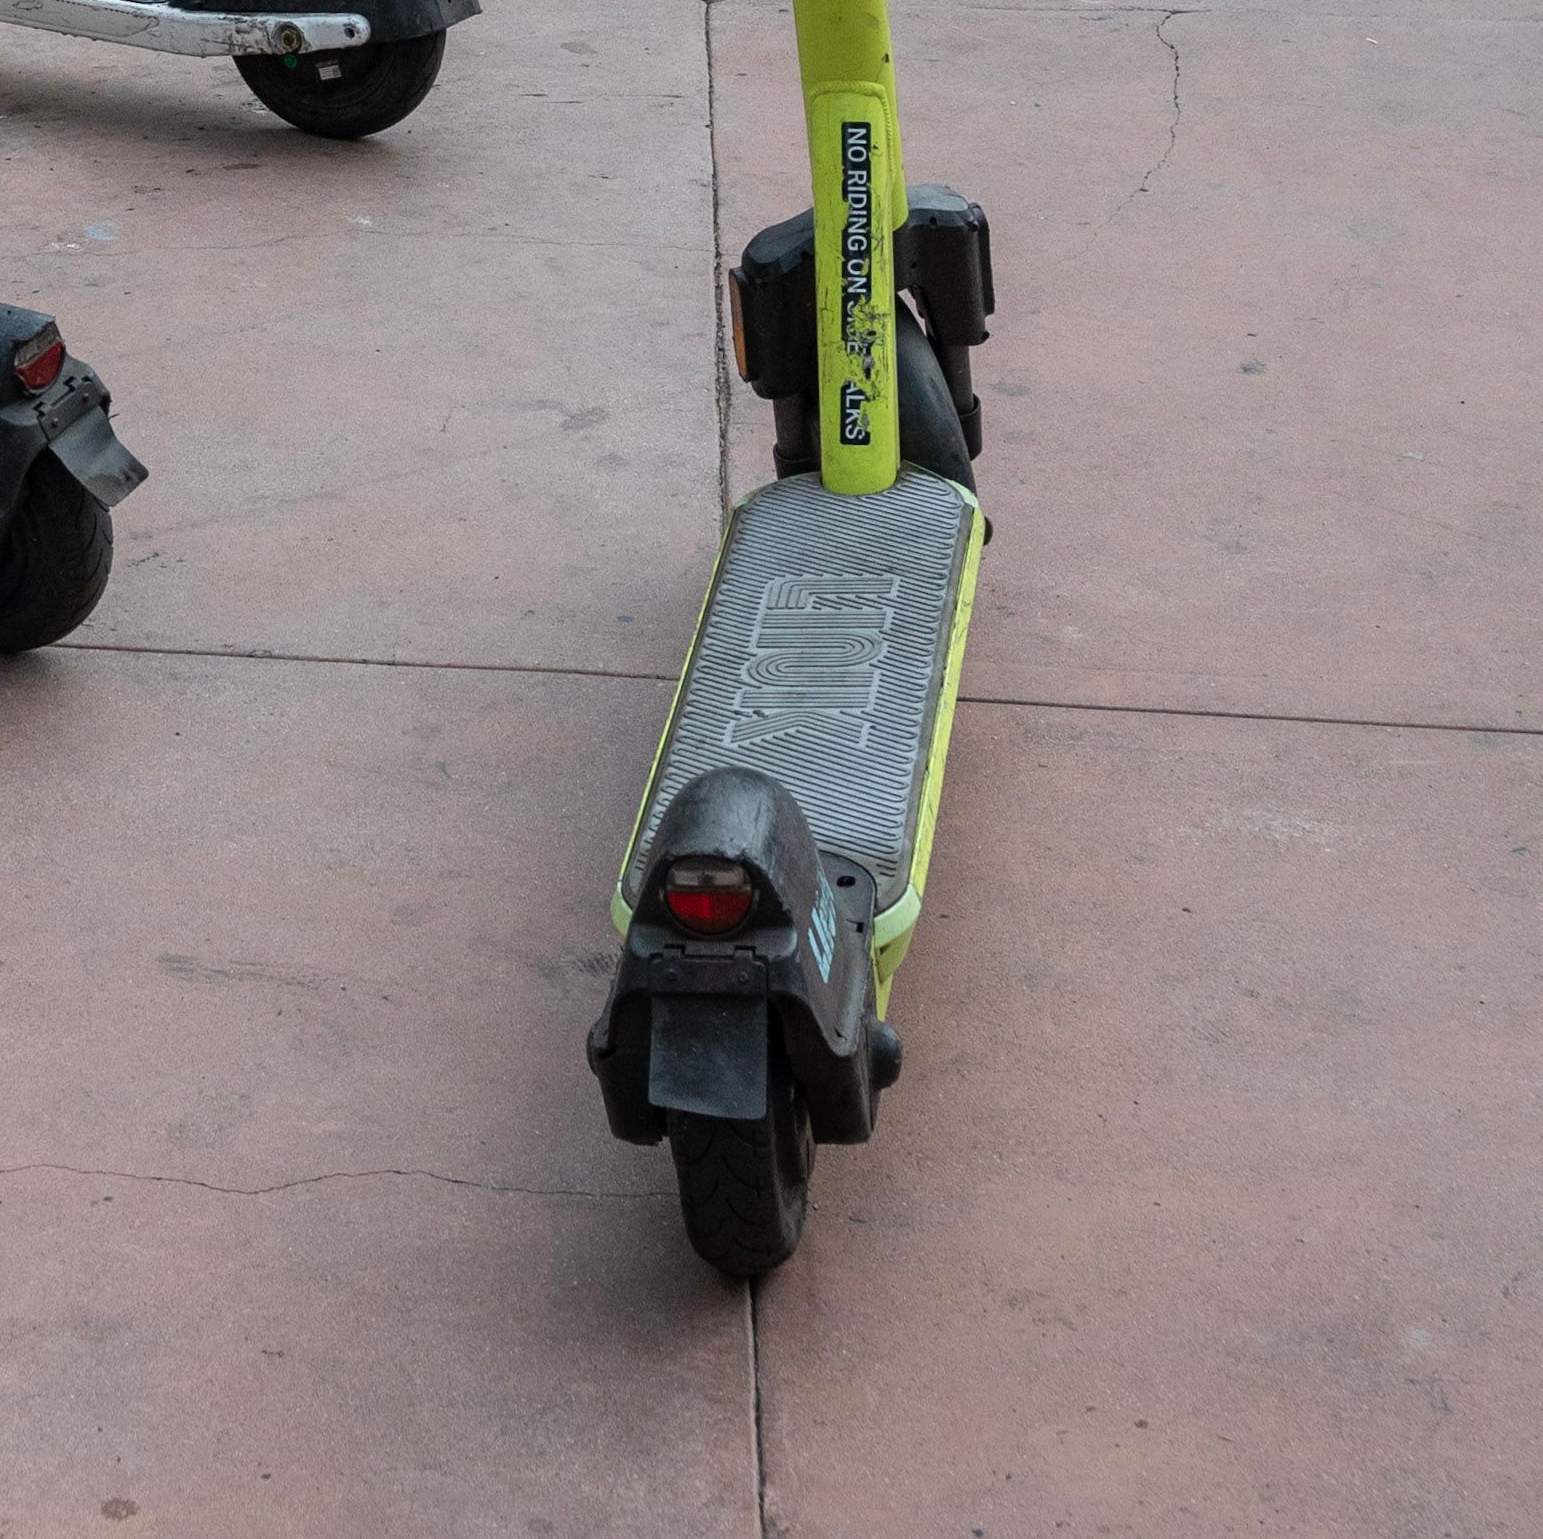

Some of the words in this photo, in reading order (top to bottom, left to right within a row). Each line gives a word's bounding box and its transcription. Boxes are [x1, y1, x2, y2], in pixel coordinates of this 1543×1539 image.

[847, 127, 867, 162] NO
[846, 169, 867, 251] RIDING
[846, 257, 867, 294] ON
[730, 578, 894, 744] LINK
